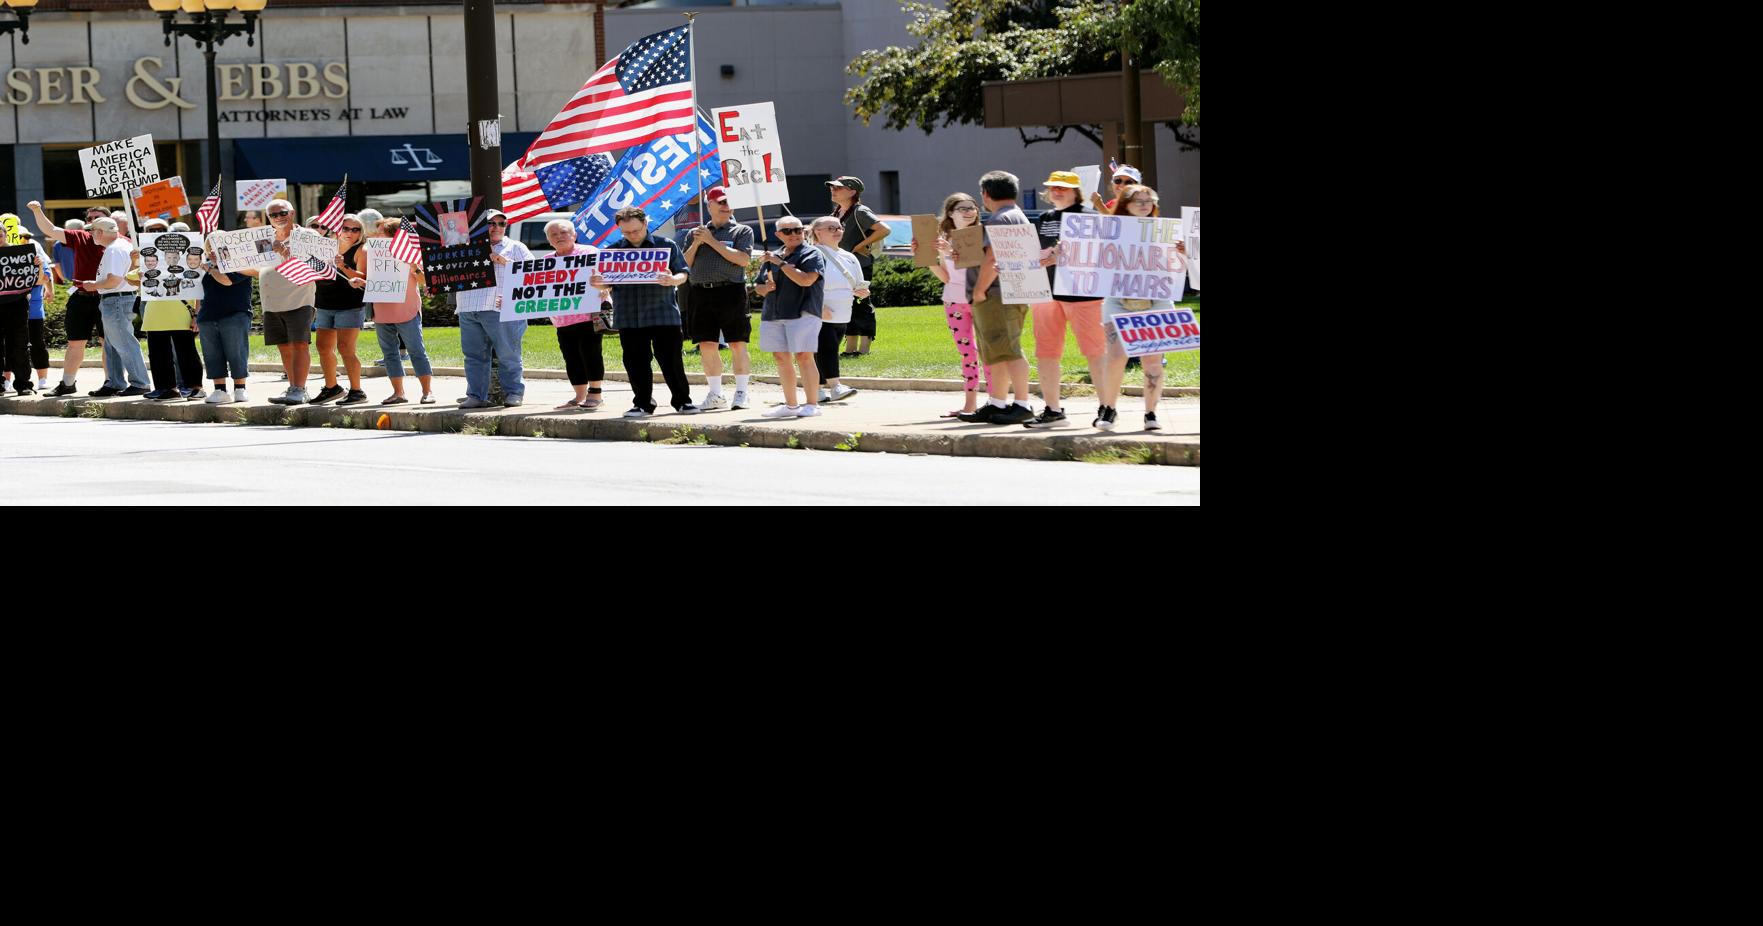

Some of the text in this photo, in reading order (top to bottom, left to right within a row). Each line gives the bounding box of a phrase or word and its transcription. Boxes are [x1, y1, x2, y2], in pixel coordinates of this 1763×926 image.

[0, 56, 349, 110] SER & EBBS
[218, 106, 409, 123] ATTORNEYS AT LAW
[92, 139, 134, 156] MAKE
[739, 145, 760, 156] the
[90, 146, 152, 168] AMERICA
[97, 158, 144, 176] GREAT
[720, 152, 785, 188] Rich
[86, 173, 159, 198] DUMP TRUMP
[99, 167, 147, 186] AGAIN
[1065, 214, 1122, 241] SEND
[1137, 218, 1182, 244] THE
[229, 243, 254, 256] THE
[429, 249, 481, 261] WORKERS
[600, 251, 669, 262] PROUD
[3, 265, 39, 277] People
[373, 258, 401, 272] RFK
[512, 253, 597, 274] FEED THE
[598, 261, 668, 273] UNION
[431, 271, 487, 285] Billionaires
[523, 269, 578, 286] NEEDY
[600, 270, 657, 282] Supporte
[1070, 271, 1174, 298] TO MARS
[512, 281, 586, 300] NOT THE
[514, 296, 582, 314] GREEDY
[1115, 311, 1192, 329] PROUD
[1120, 323, 1200, 343] UNION
